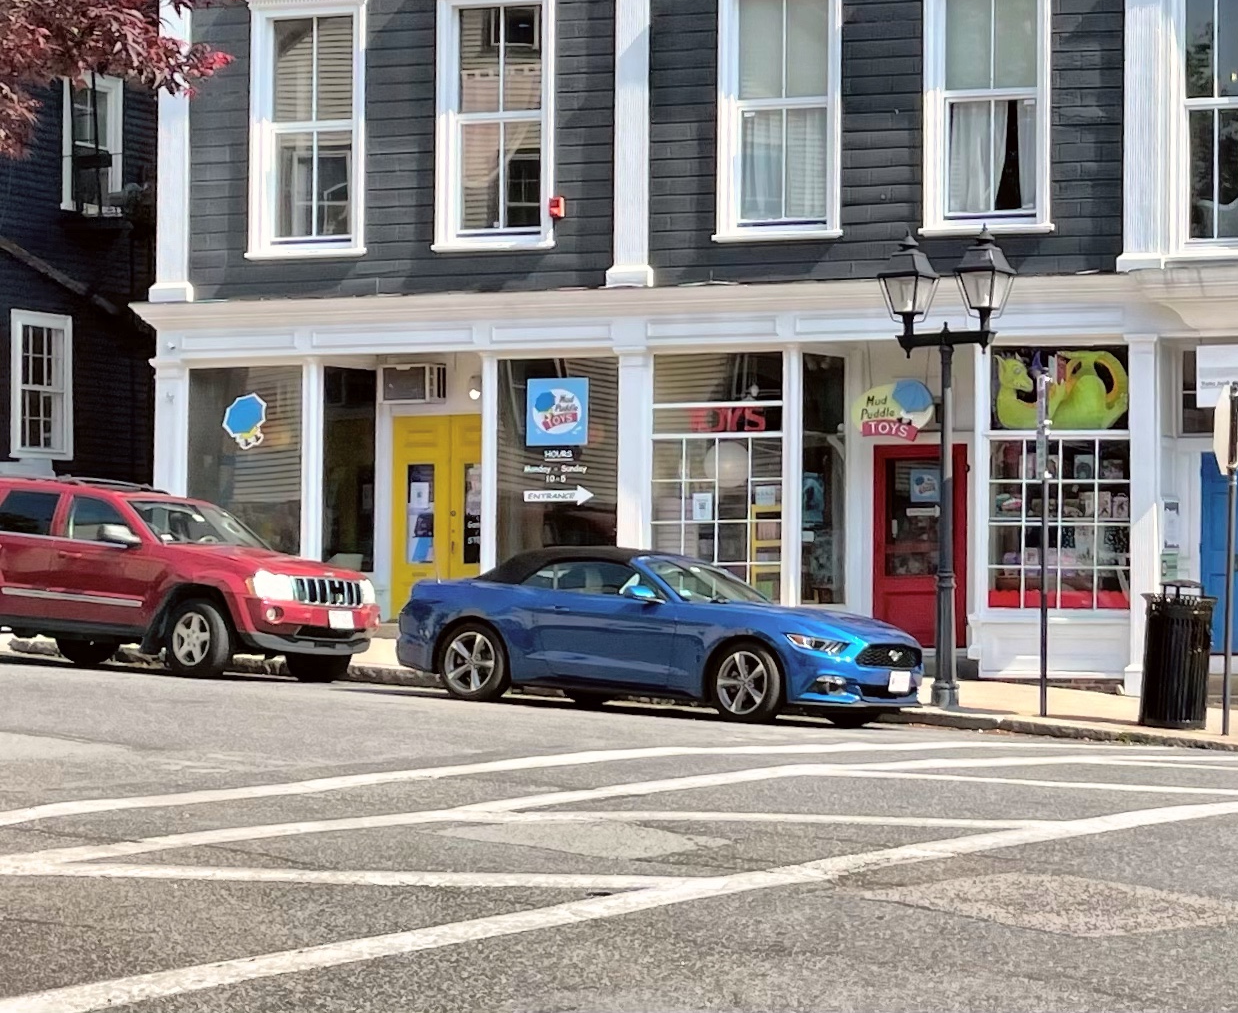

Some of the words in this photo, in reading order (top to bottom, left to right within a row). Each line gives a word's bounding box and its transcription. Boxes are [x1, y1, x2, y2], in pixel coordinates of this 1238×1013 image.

[866, 395, 888, 408] Mud
[860, 408, 896, 421] Puddle
[868, 421, 910, 438] TOYS
[543, 449, 573, 458] HOURS
[560, 464, 588, 475] Sunday
[527, 492, 576, 500] ENTRANCE
